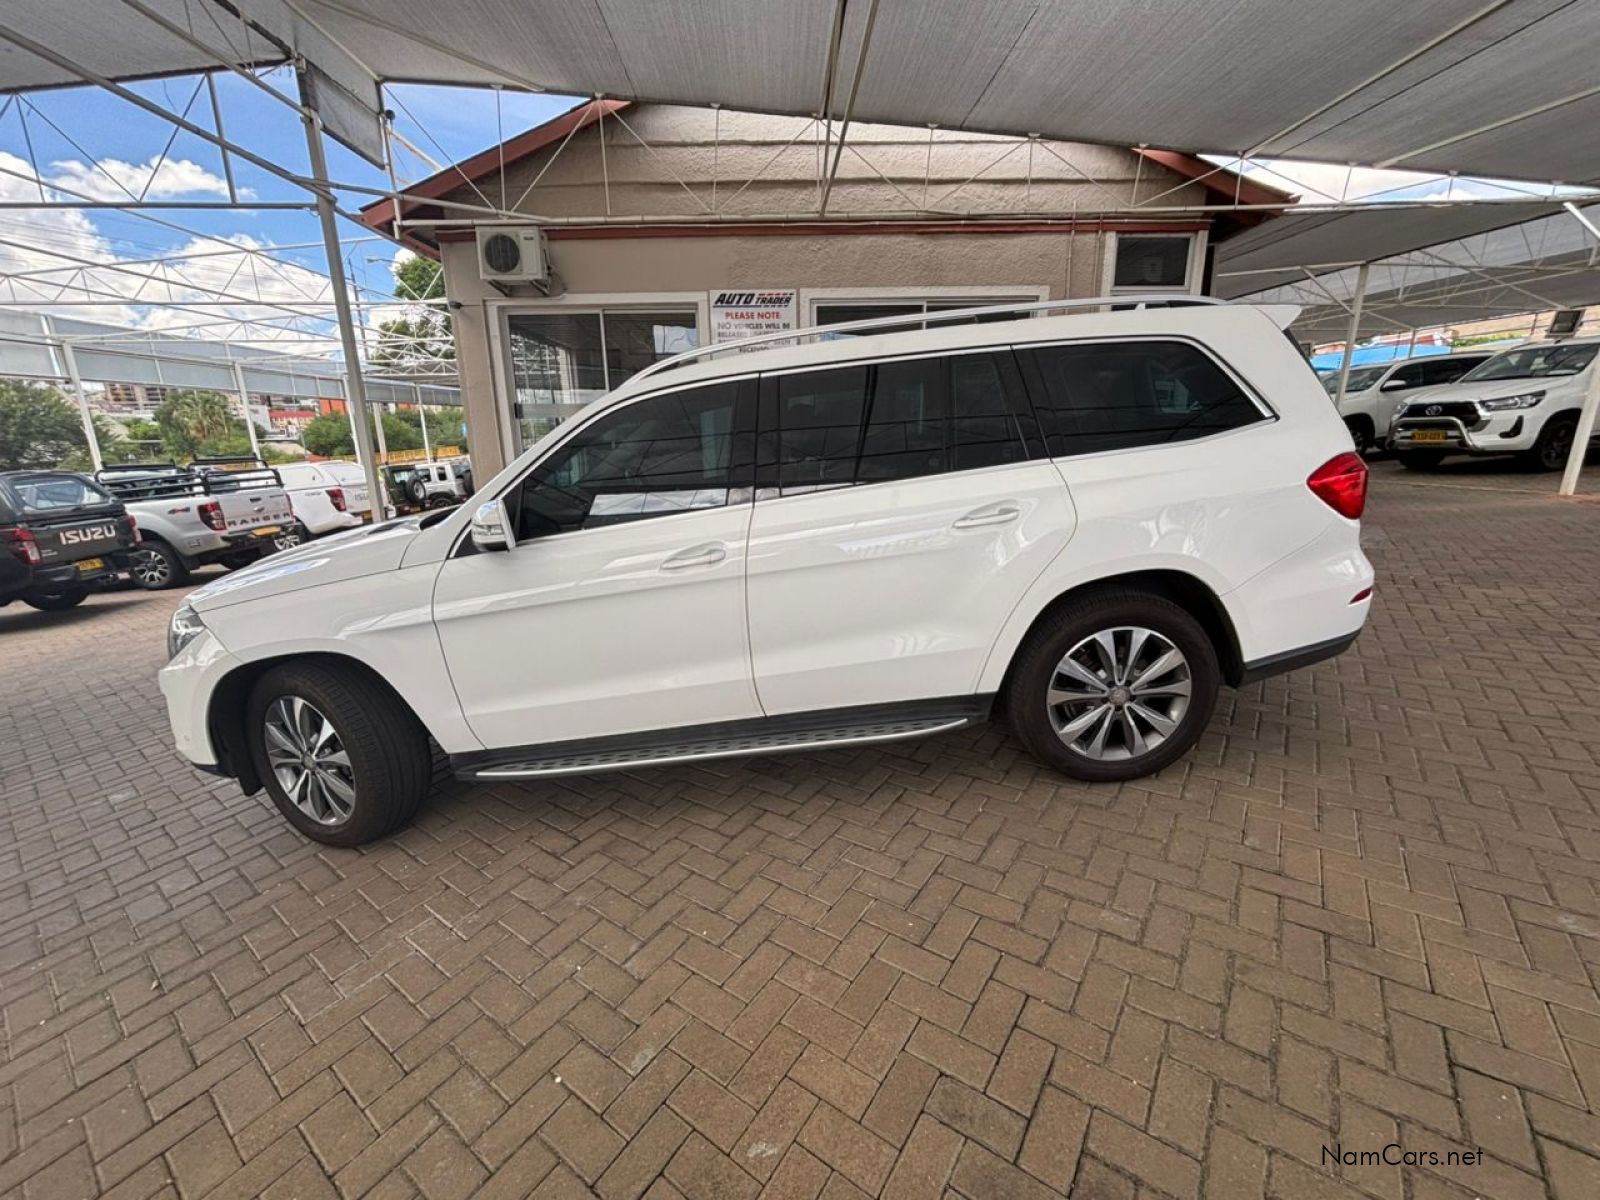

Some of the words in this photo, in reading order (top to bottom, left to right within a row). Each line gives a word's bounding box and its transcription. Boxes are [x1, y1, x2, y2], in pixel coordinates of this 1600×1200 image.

[714, 293, 756, 305] AUTO
[755, 296, 792, 304] TRADER
[725, 311, 755, 320] PLEASE
[718, 322, 732, 330] NO
[733, 322, 764, 330] VEHICLES
[765, 322, 780, 330] WILL
[227, 512, 290, 527] RANGER
[60, 525, 116, 545] ISUZU
